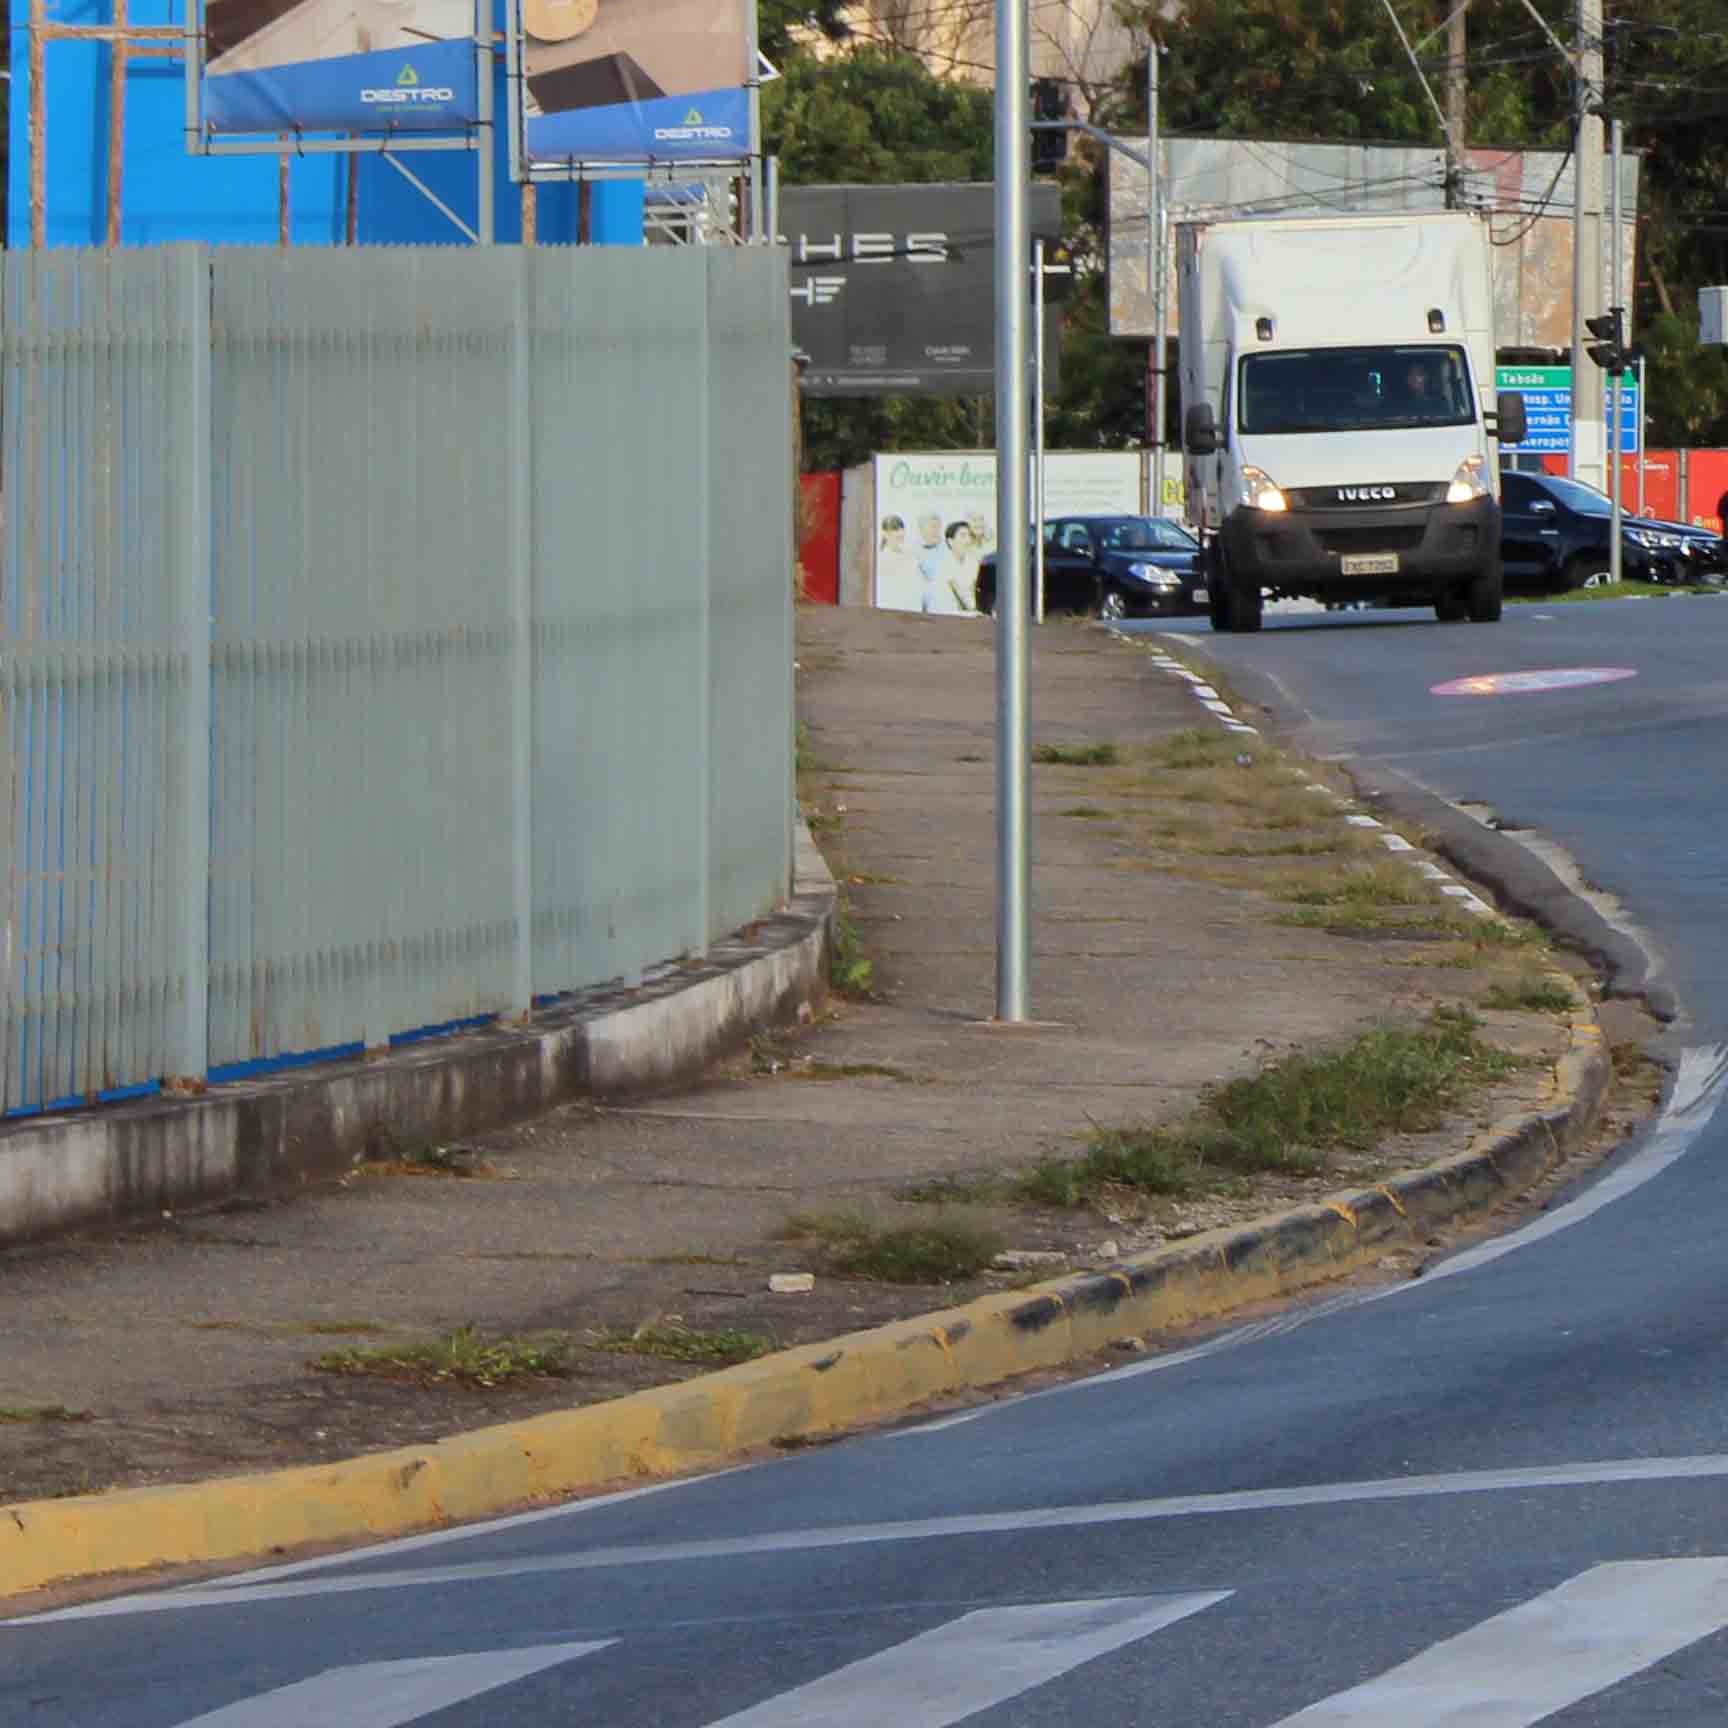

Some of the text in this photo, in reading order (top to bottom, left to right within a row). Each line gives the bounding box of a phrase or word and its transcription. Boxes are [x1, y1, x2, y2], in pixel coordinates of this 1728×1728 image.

[360, 87, 453, 103] DESTRO
[1526, 413, 1561, 426] ernão
[1337, 486, 1396, 501] IVECO
